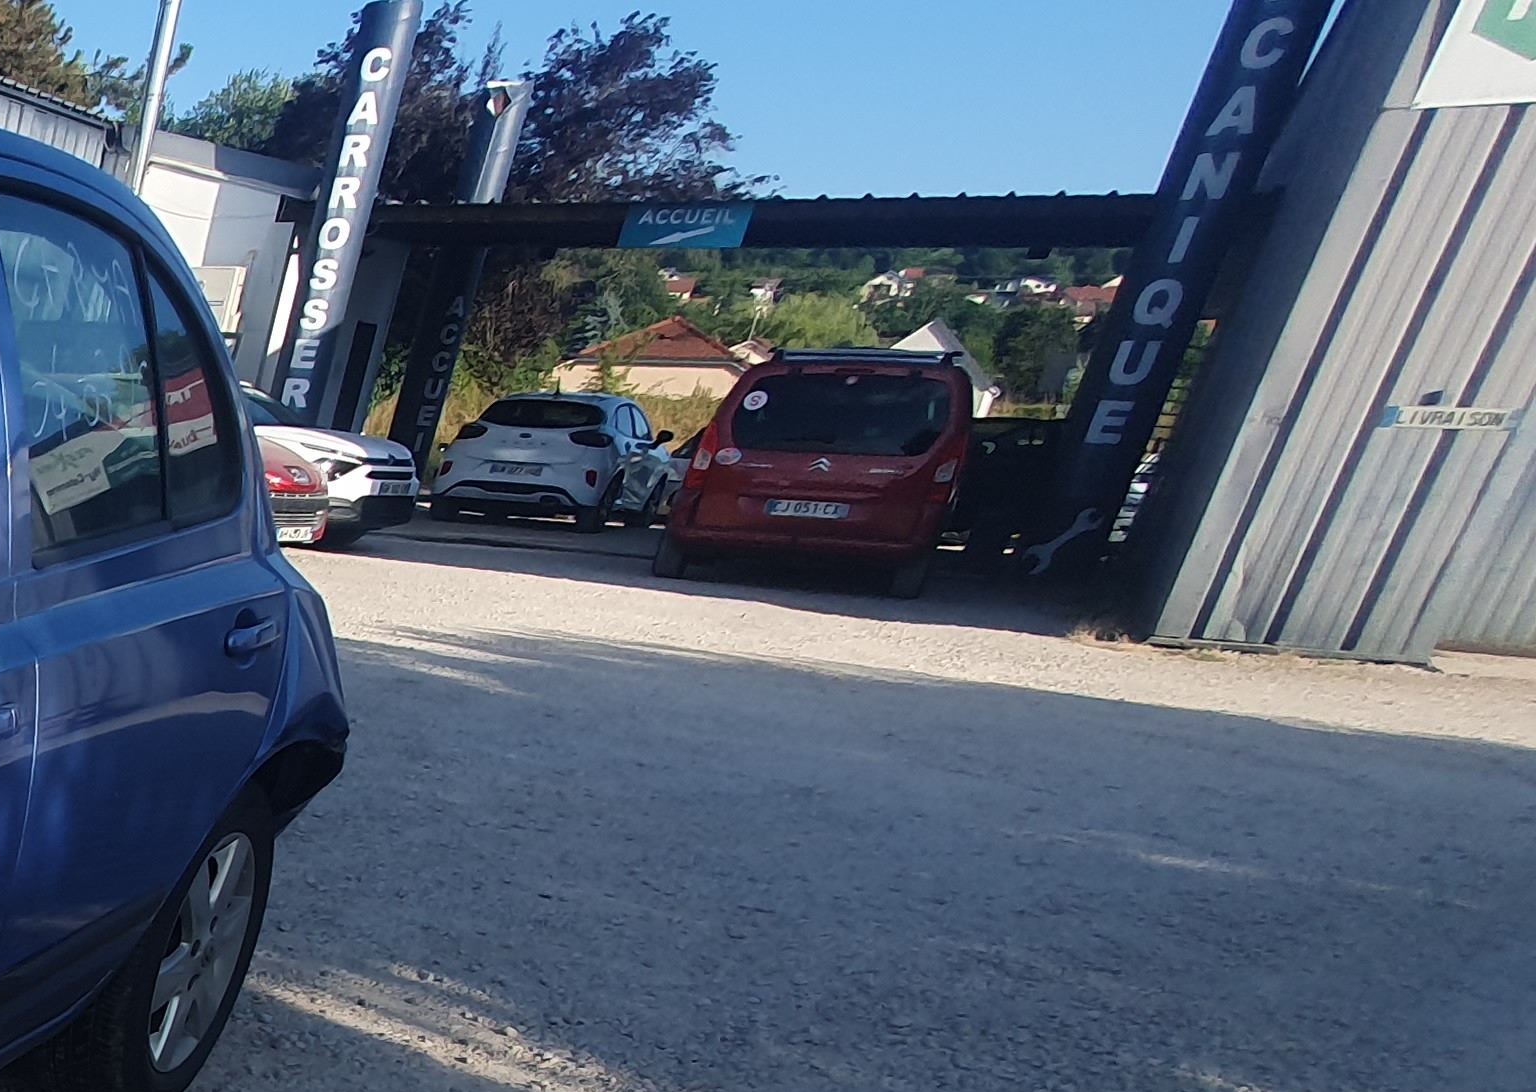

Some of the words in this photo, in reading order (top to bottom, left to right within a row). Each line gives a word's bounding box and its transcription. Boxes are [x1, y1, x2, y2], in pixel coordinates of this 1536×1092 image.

[638, 209, 735, 225] ACCUEIL
[1084, 0, 1294, 444] CANIQUE
[1395, 410, 1508, 427] LIVRAISON
